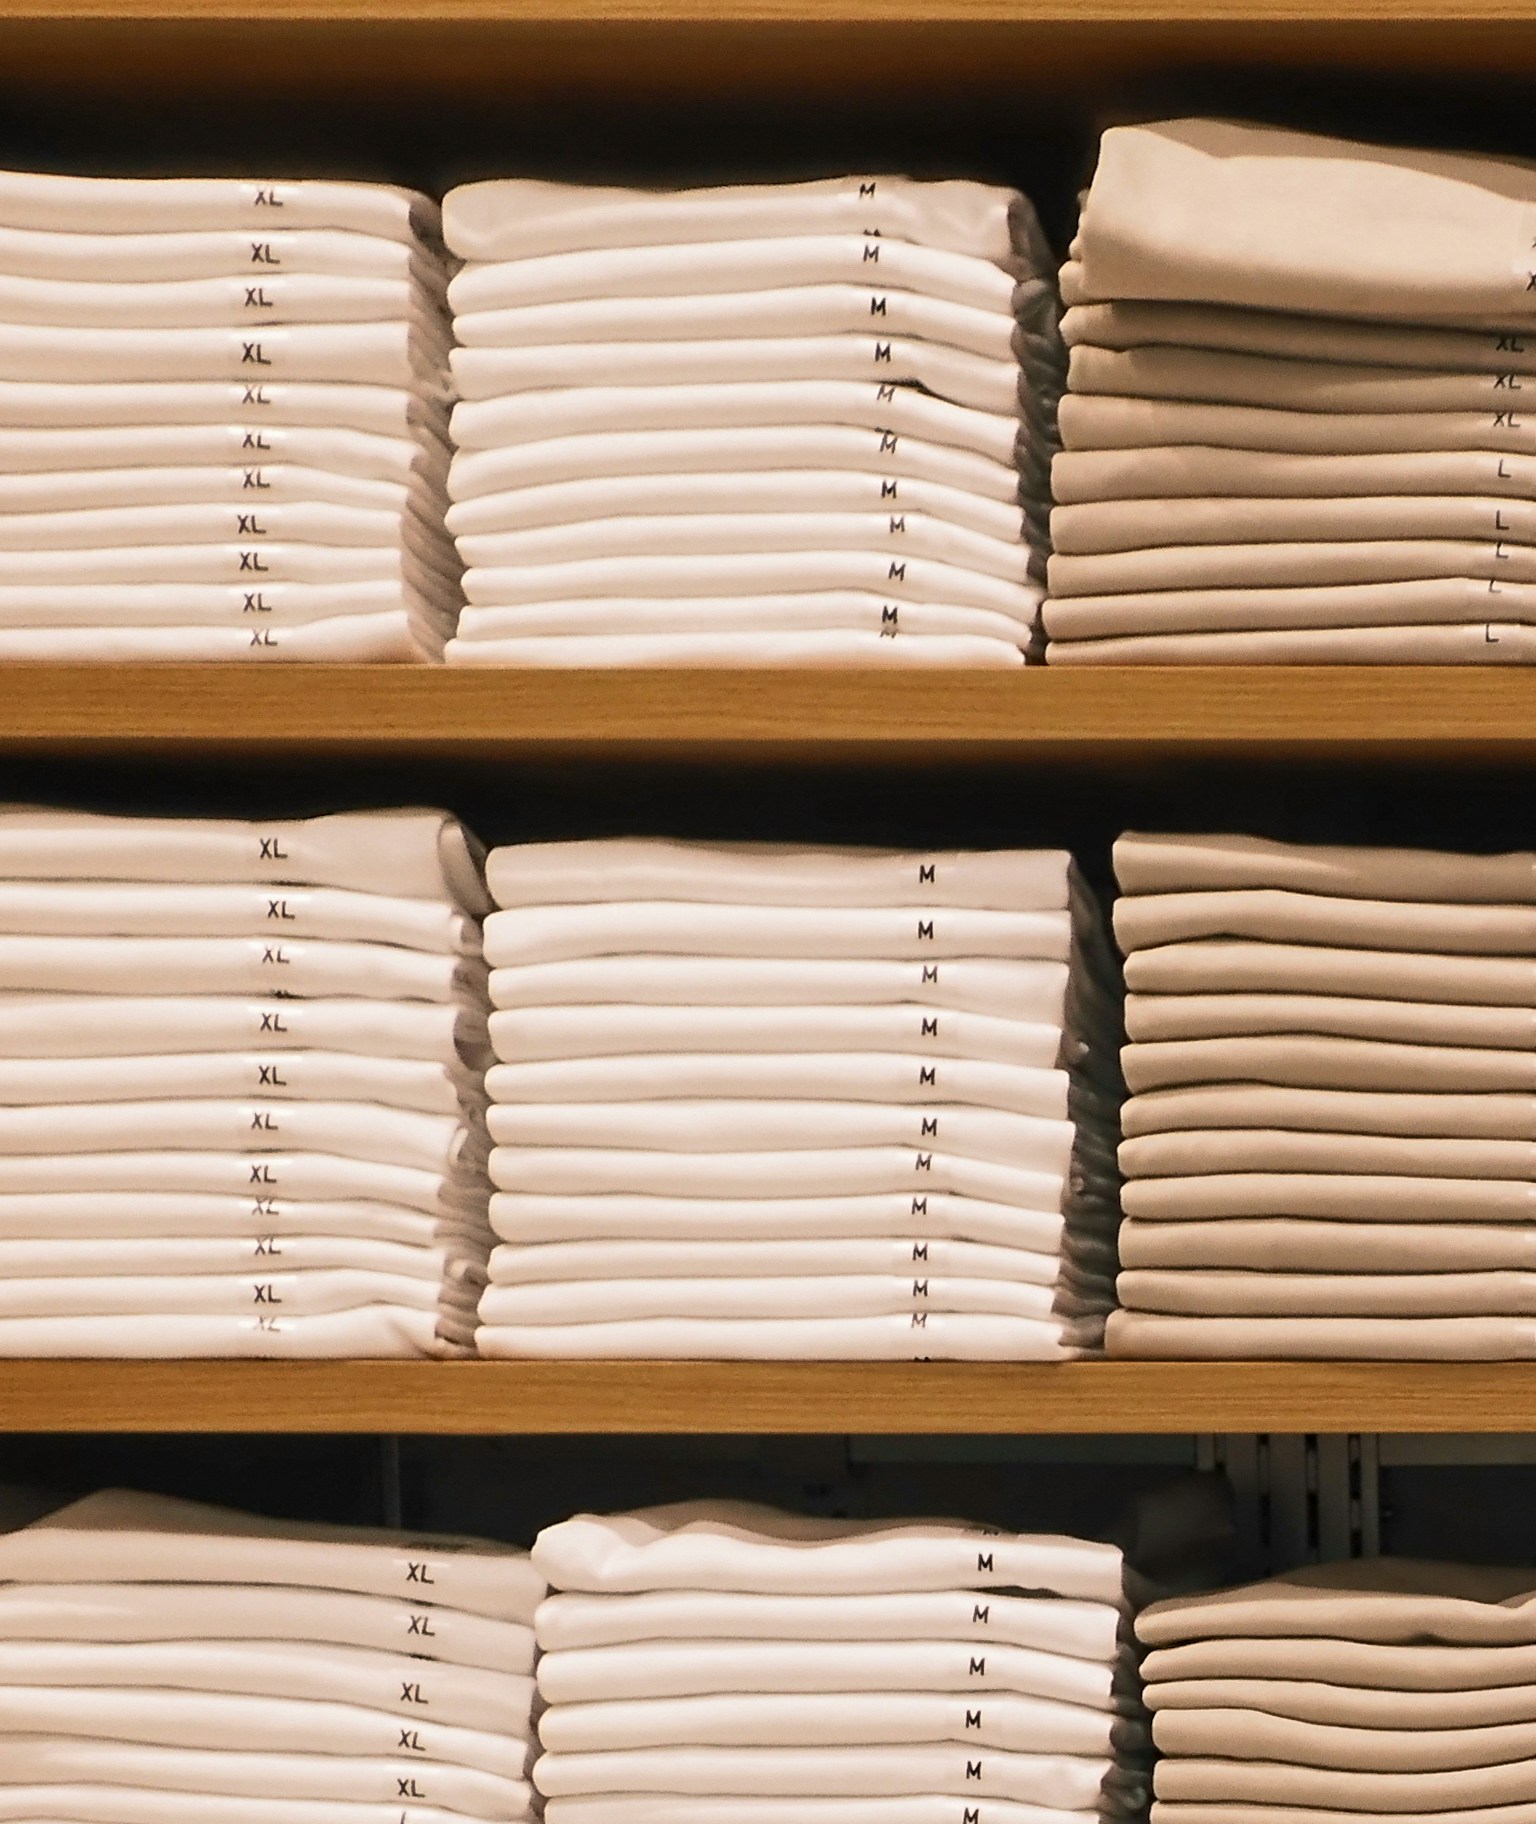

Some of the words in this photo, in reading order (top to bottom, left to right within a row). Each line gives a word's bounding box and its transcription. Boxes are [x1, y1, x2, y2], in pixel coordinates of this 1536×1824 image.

[251, 243, 280, 264] XL
[245, 288, 273, 306] XL
[871, 297, 886, 316] M
[242, 343, 271, 365] XL
[875, 342, 890, 362] M
[881, 481, 897, 498] M
[237, 515, 266, 534] XL
[1496, 510, 1509, 530] L
[888, 562, 905, 581] M
[243, 593, 271, 612] XL
[882, 605, 897, 624] M
[1486, 624, 1499, 642] L
[260, 839, 288, 859] XL
[920, 865, 935, 883] M
[267, 901, 295, 920] XL
[918, 921, 933, 939] M
[259, 1065, 287, 1086] XL
[920, 1066, 935, 1085] M
[251, 1113, 278, 1130] XL
[921, 1118, 937, 1136] M
[912, 1243, 928, 1260] M
[254, 1285, 282, 1303] XL
[978, 1554, 993, 1571] M
[406, 1563, 434, 1584] XL
[973, 1605, 989, 1623] M
[400, 1683, 428, 1704] XL
[398, 1730, 426, 1751] XL
[966, 1761, 981, 1780] M
[398, 1779, 425, 1797] XL
